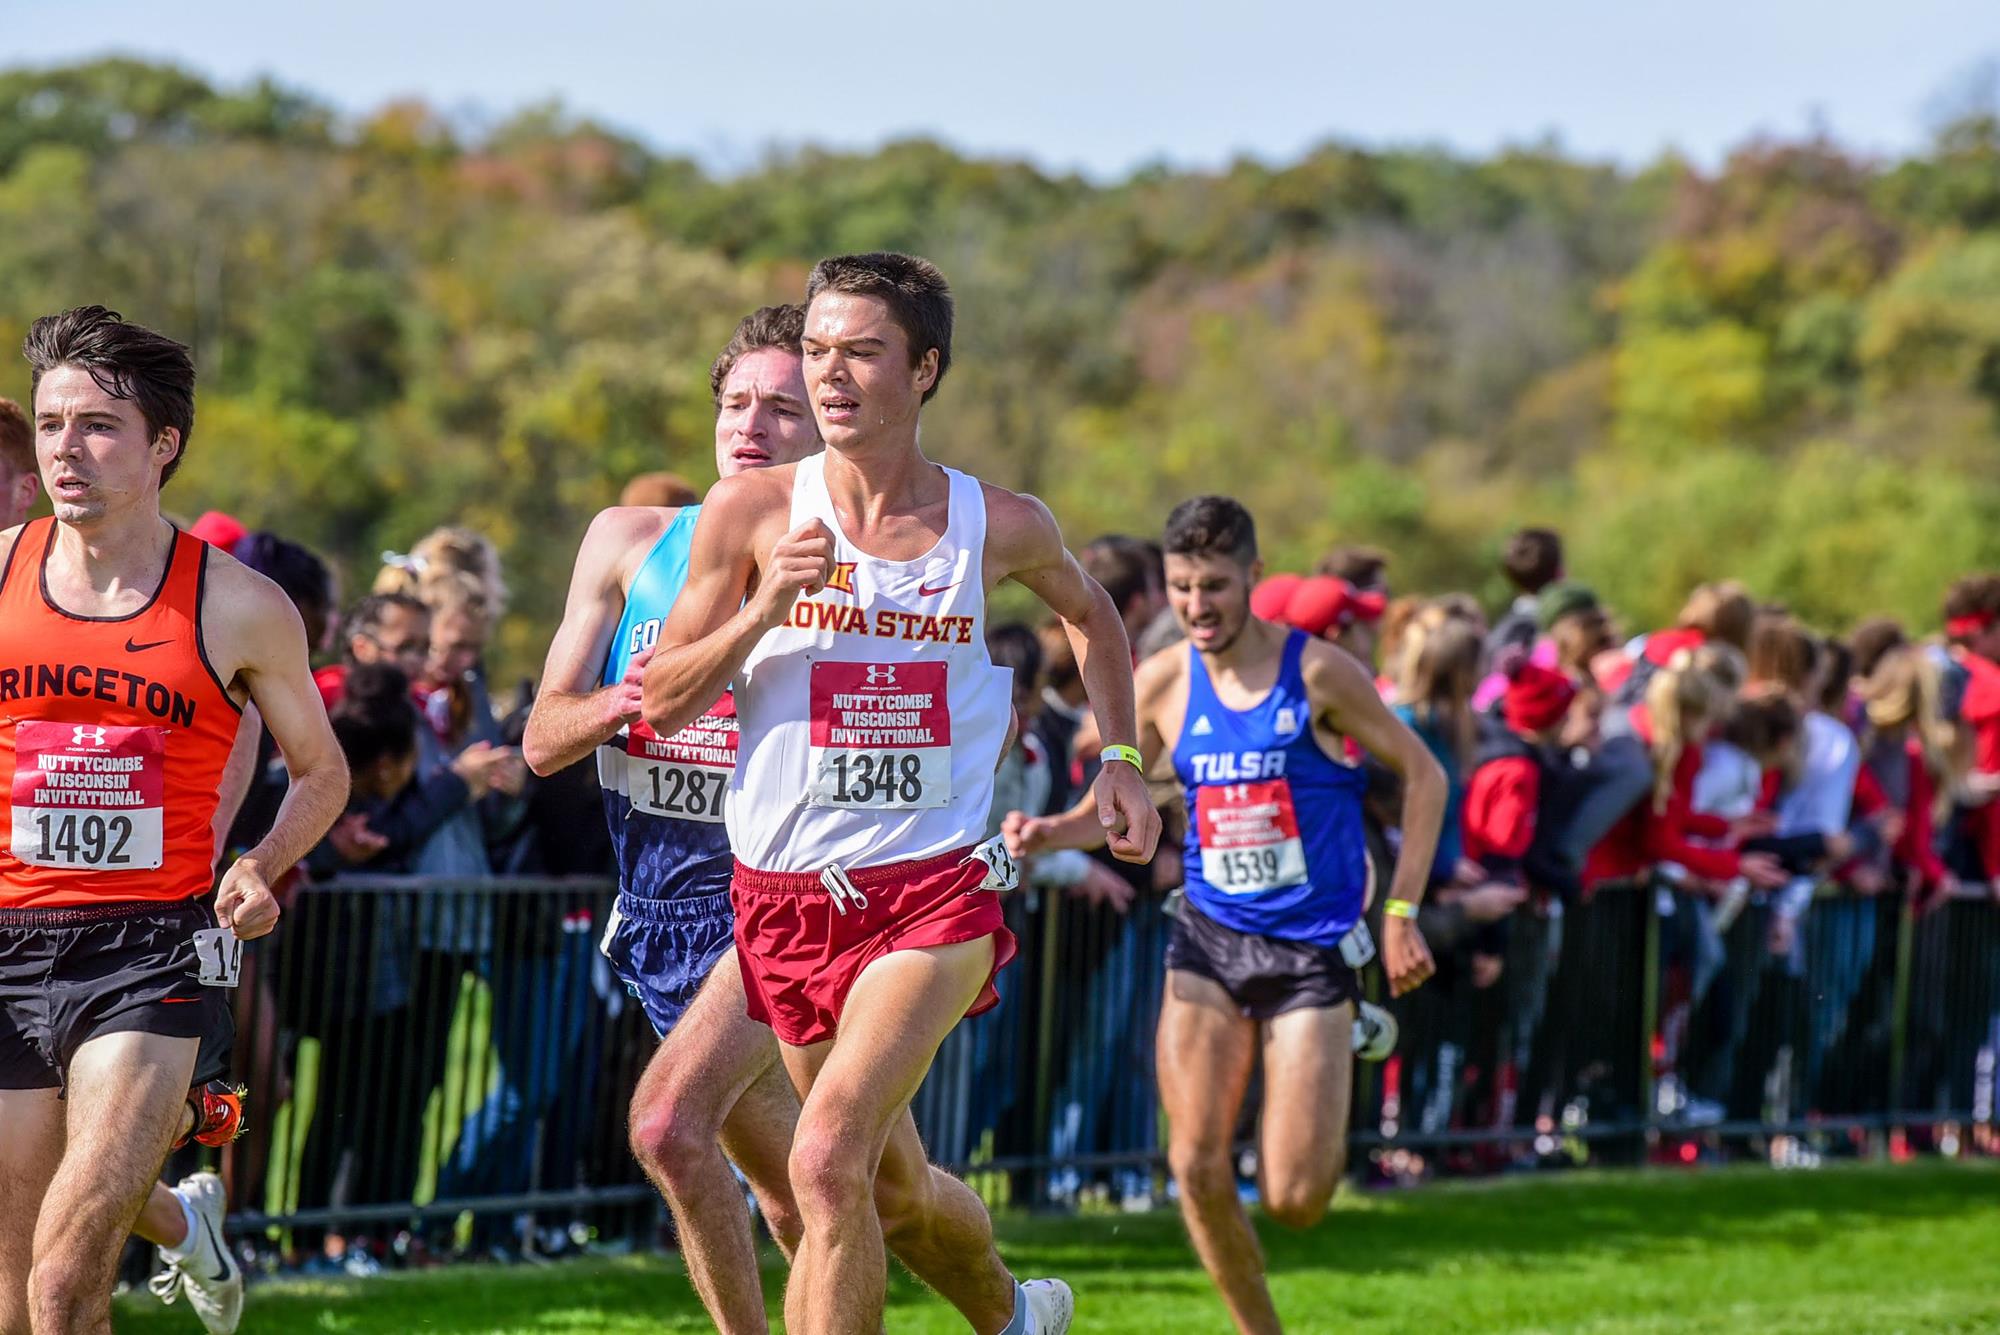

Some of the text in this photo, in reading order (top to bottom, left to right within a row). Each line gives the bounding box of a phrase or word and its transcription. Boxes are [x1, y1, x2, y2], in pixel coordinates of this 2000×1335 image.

[630, 617, 665, 654] CO
[875, 610, 974, 644] STATE
[833, 693, 933, 710] NUTTYCOMBE
[842, 711, 920, 727] WISCONSIN
[655, 728, 728, 747] SCONSIN
[831, 728, 935, 744] INVITATIONAL
[38, 754, 144, 772] NUTTYCOMBE
[1190, 749, 1287, 783] TULSA
[46, 772, 130, 788] WISCONSIN
[648, 766, 727, 817] 1287
[832, 754, 922, 803] 1348
[34, 788, 145, 806] INVITATIONAL
[36, 814, 133, 864] 1492
[1222, 848, 1279, 885] 1539
